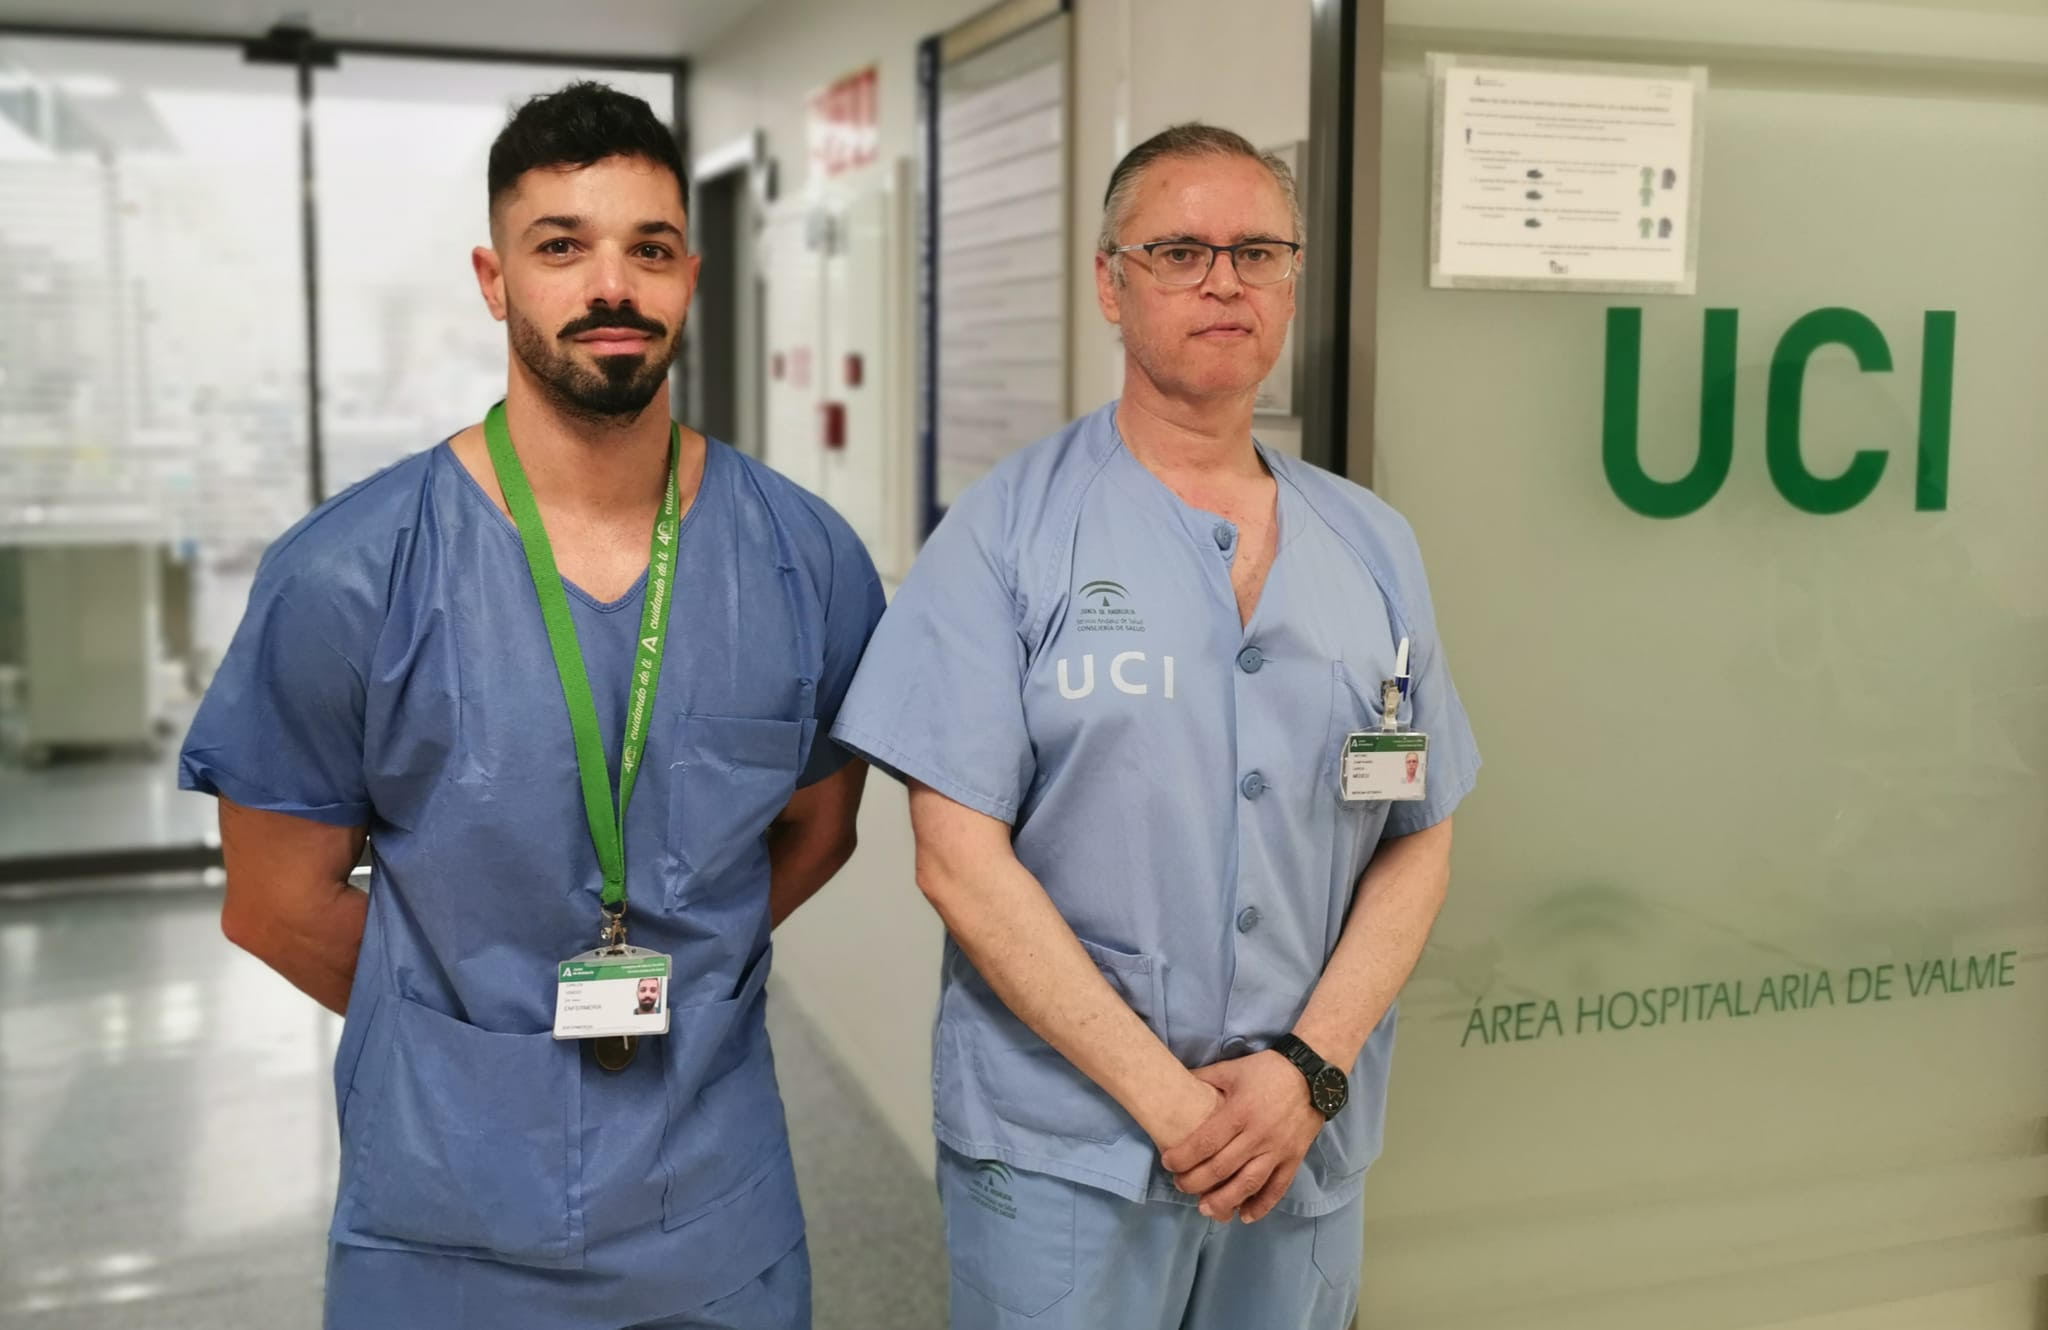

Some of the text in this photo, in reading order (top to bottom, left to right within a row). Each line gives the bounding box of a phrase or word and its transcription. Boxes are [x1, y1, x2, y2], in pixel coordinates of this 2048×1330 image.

[1602, 306, 1957, 519] UCI
[655, 562, 668, 577] de
[656, 551, 669, 561] ti
[650, 578, 666, 630] cuidando
[638, 670, 650, 686] de
[640, 658, 653, 669] ti
[1057, 651, 1174, 699] UCI
[631, 687, 647, 740] cuidando
[1460, 950, 2018, 1047] ÁREA HOSPITALARIA DE VALME
